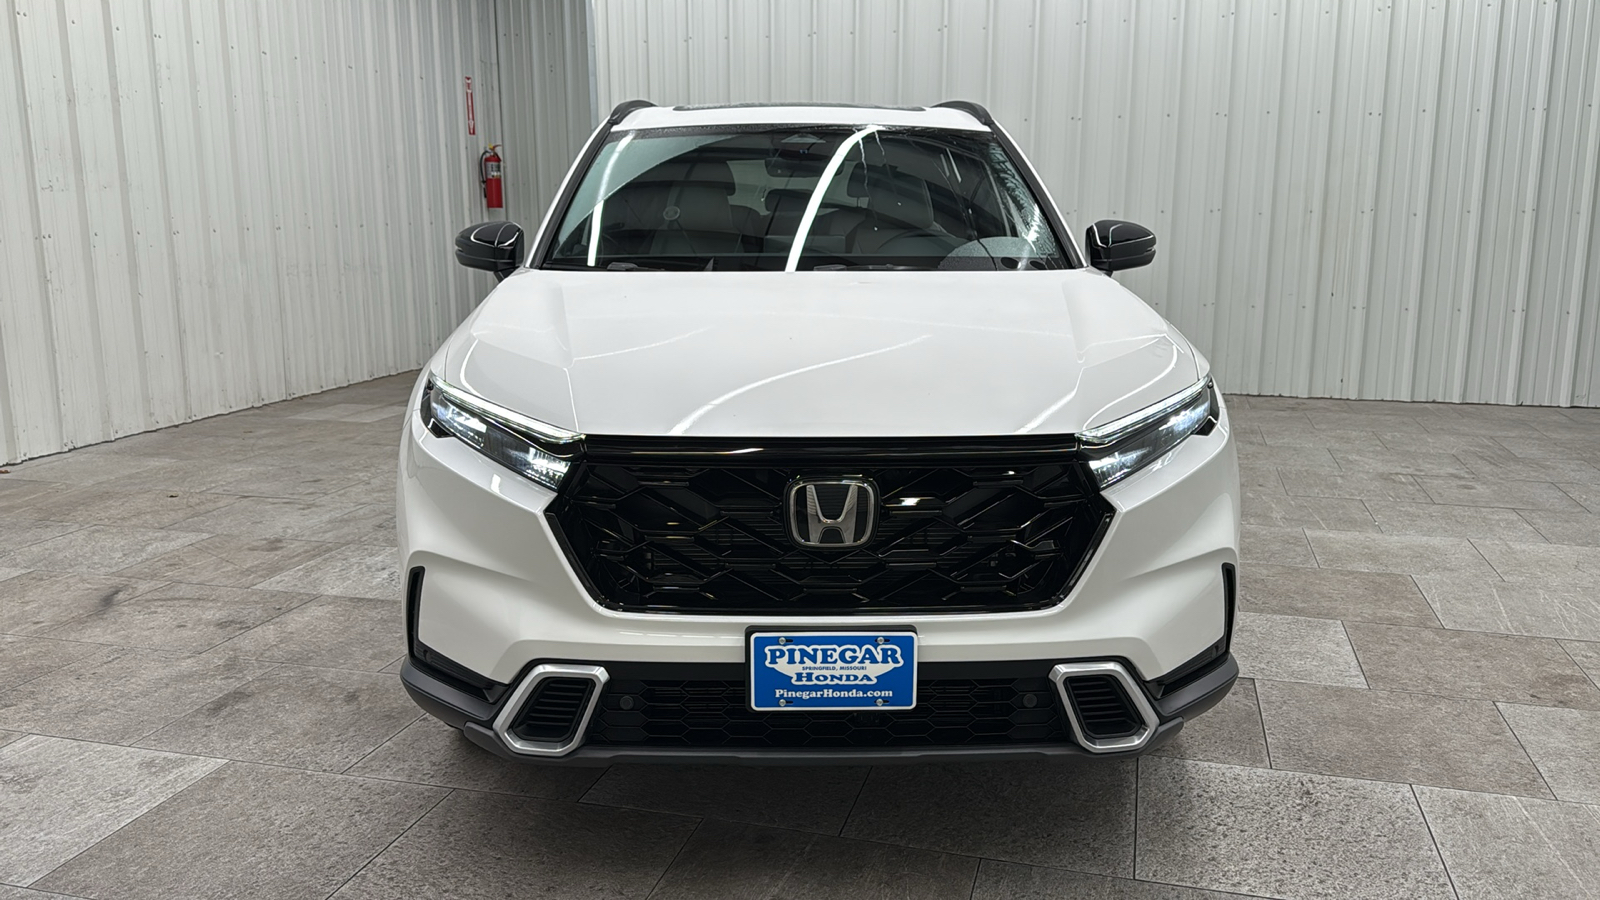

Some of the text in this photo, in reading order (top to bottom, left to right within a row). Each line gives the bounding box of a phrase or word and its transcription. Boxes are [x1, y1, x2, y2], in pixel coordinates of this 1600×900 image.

[768, 647, 902, 665] PINEGAR
[794, 672, 874, 682] HONDA
[775, 689, 893, 699] PinegarHonda.com
